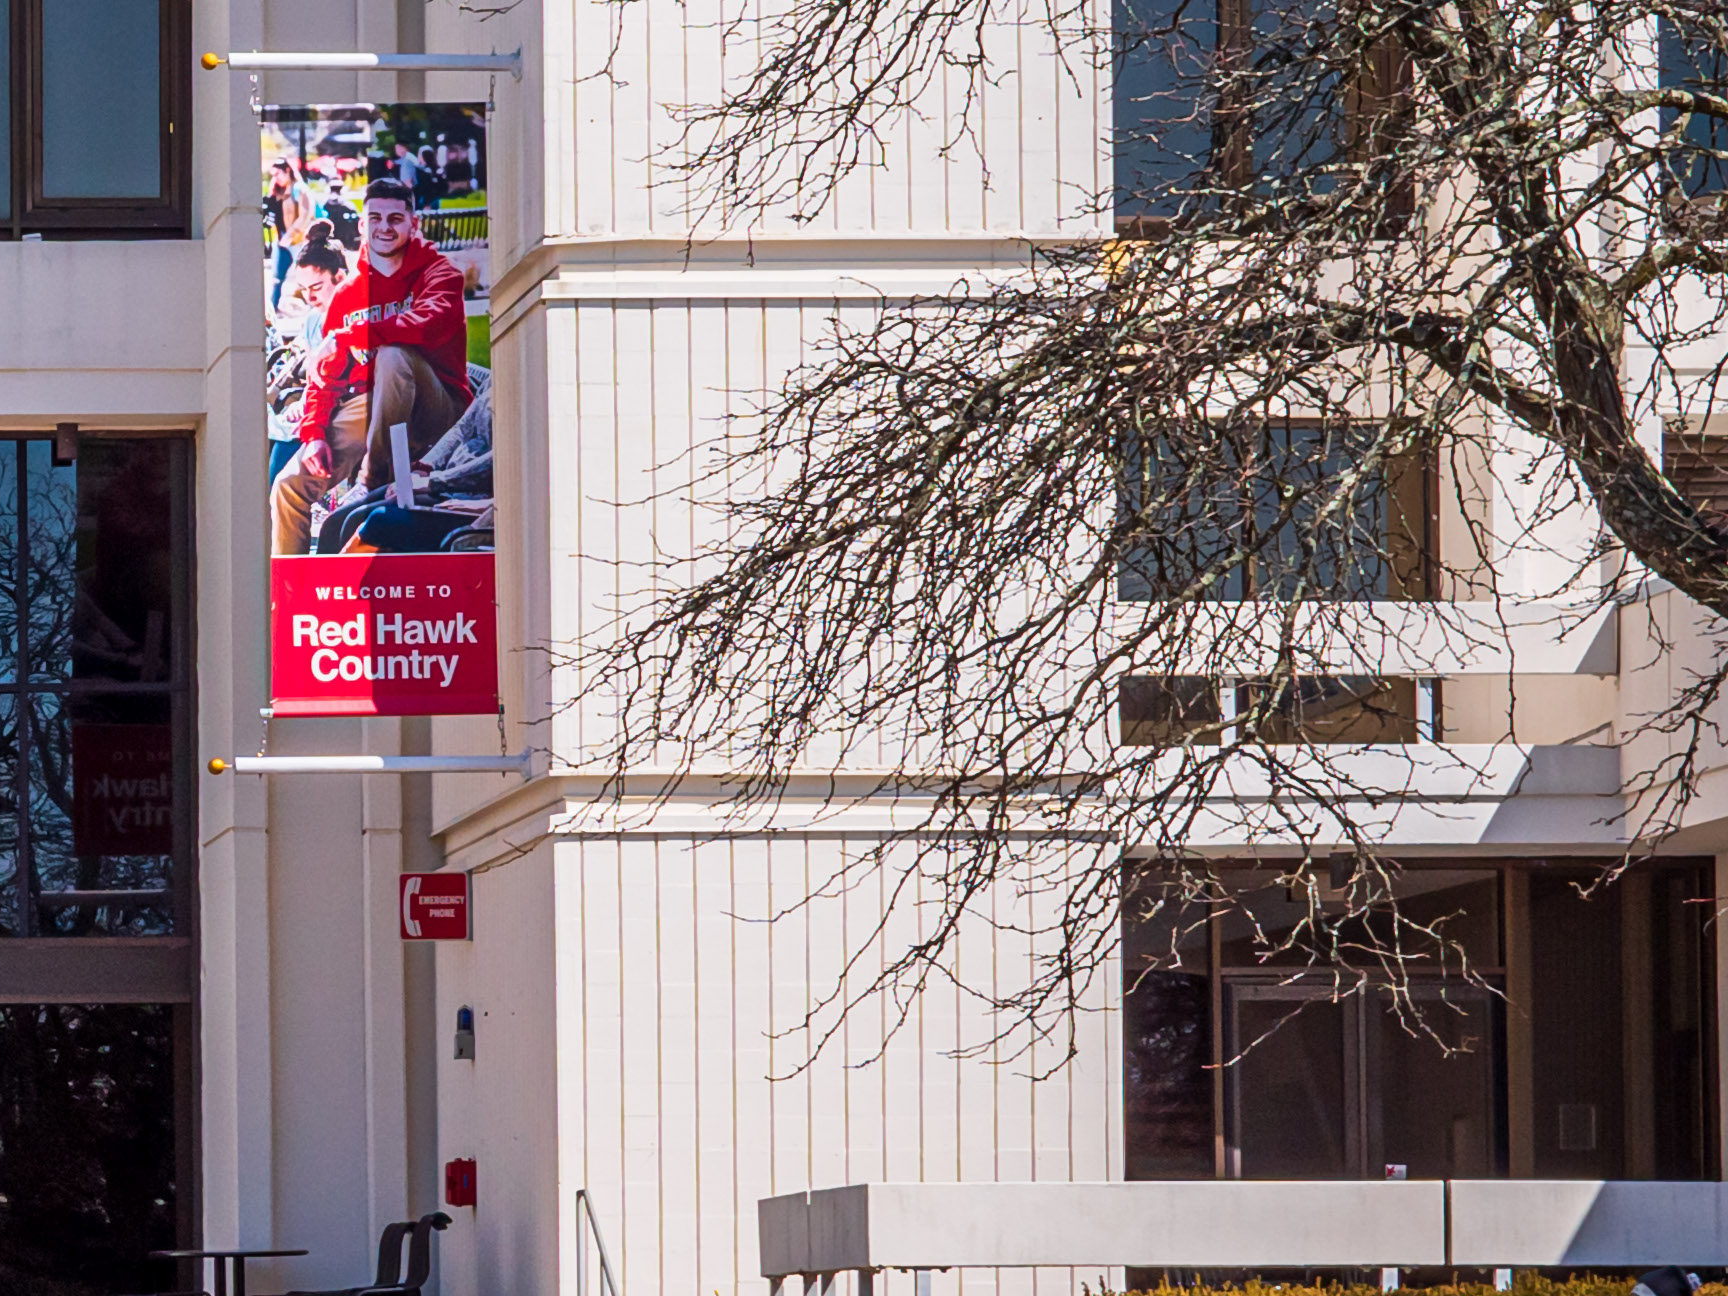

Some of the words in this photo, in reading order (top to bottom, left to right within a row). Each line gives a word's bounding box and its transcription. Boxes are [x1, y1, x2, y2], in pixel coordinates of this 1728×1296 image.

[315, 585, 415, 600] WELCOME
[426, 585, 451, 598] TO
[292, 613, 366, 647] Red
[376, 612, 478, 645] Hawk
[310, 648, 460, 688] Country
[418, 895, 465, 905] EMERGENCY
[429, 908, 455, 917] PHONE
